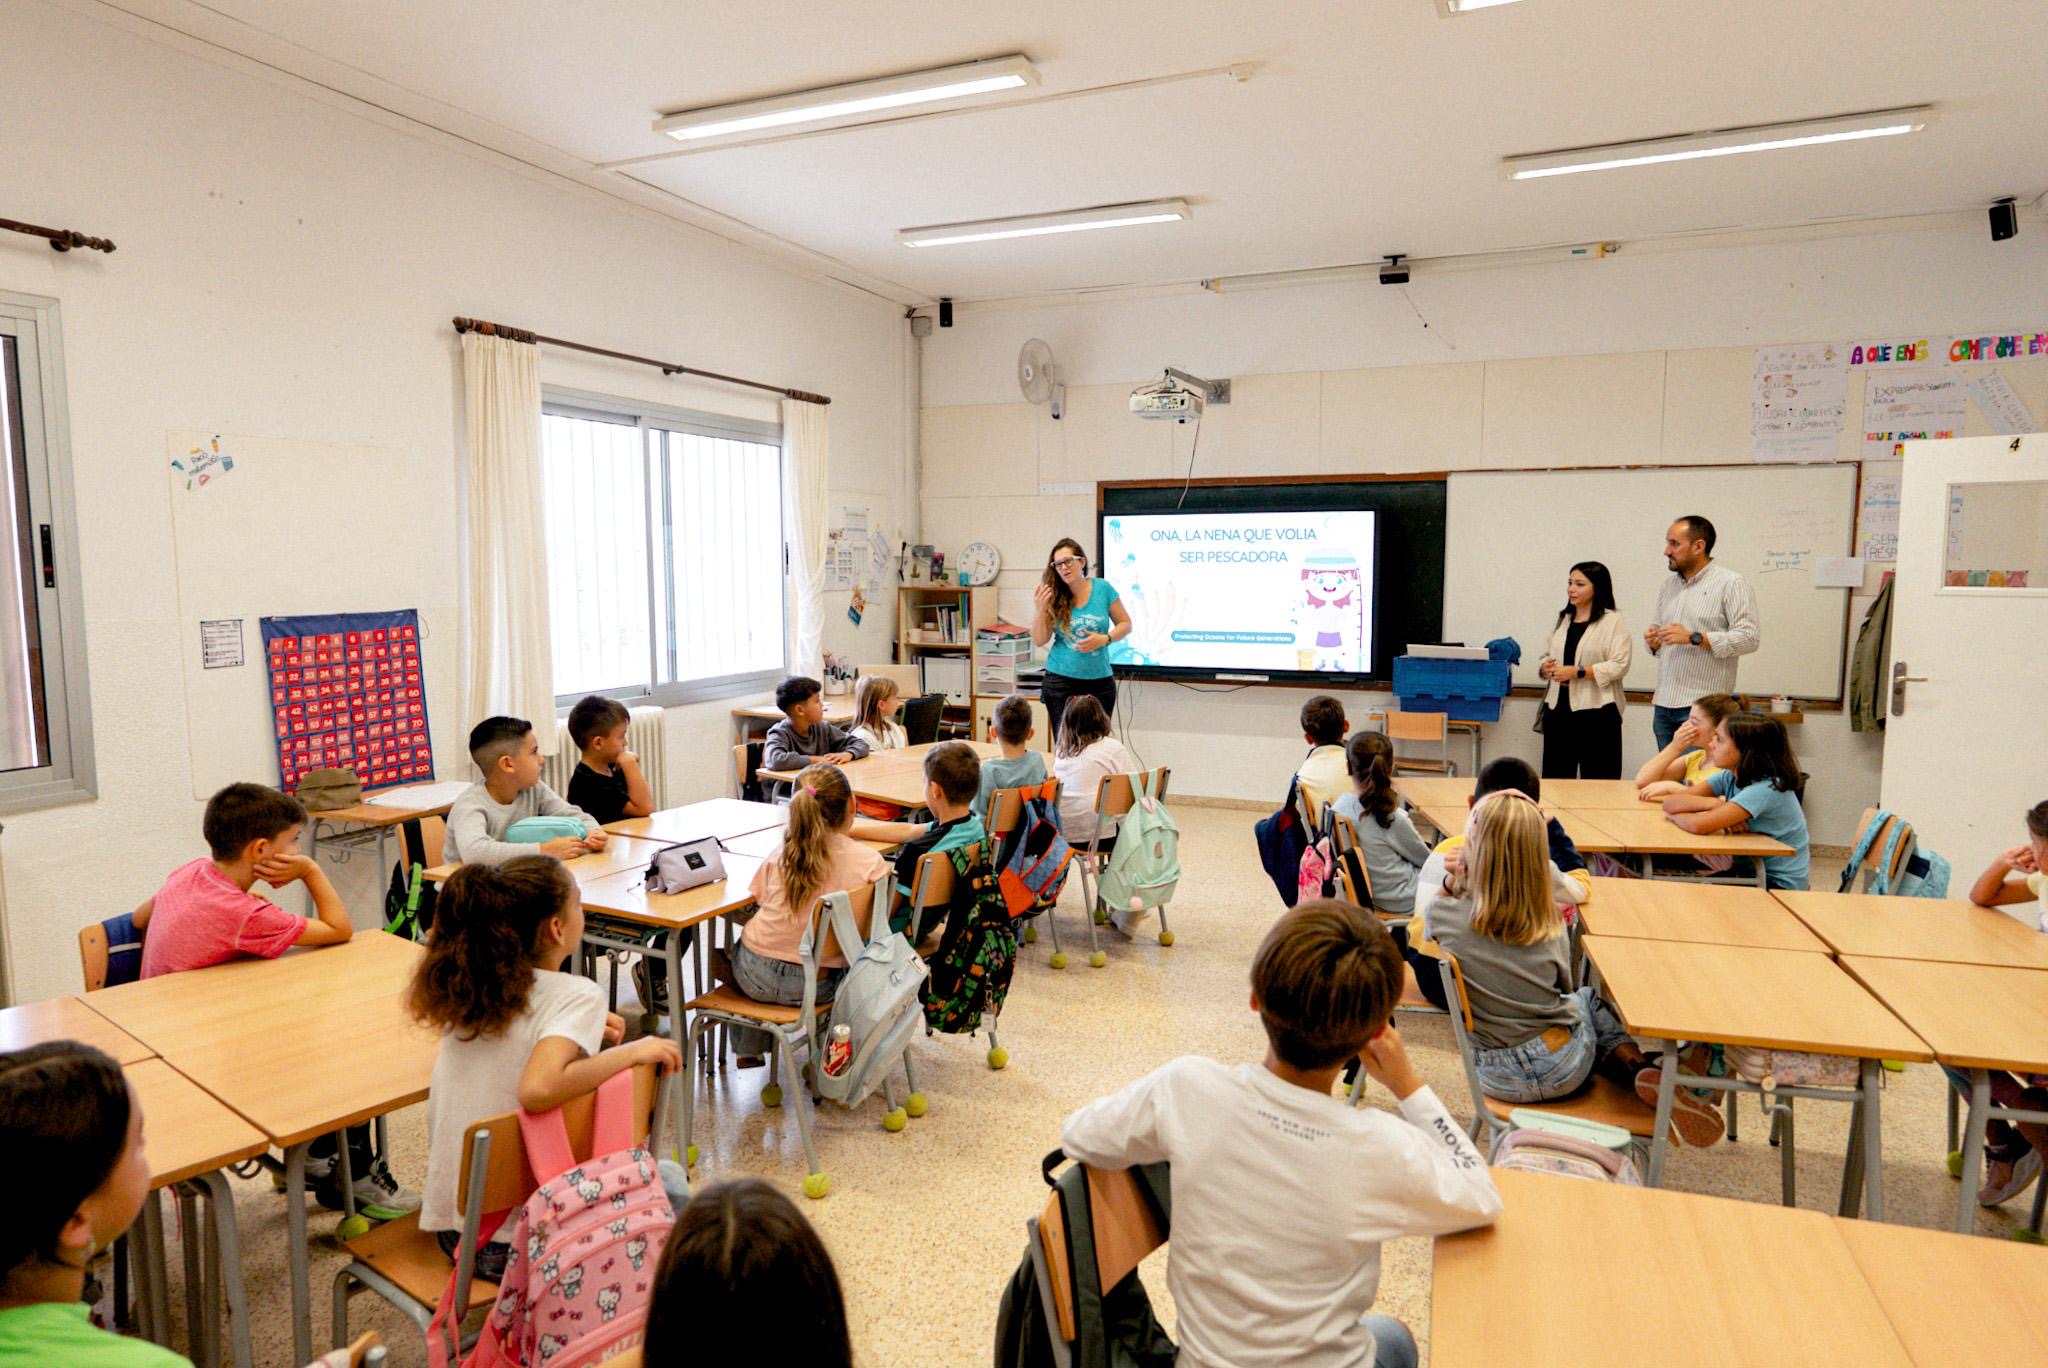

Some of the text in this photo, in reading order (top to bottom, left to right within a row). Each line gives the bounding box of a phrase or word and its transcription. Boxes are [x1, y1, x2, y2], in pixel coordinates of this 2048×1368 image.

[1851, 346, 1863, 364] A
[1895, 339, 1929, 362] ENS
[2010, 438, 2020, 451] 4
[1150, 528, 1317, 543] ONA, LA NENA QUE VOLIA
[1179, 551, 1288, 563] SER PESCADORA
[288, 640, 294, 649] 2
[350, 634, 356, 643] 6
[404, 629, 412, 637] 10
[410, 704, 421, 713] 60
[412, 719, 423, 727] 70
[414, 734, 425, 743] 80
[1271, 1122, 1280, 1130] TO
[1282, 1119, 1299, 1128] NEW
[1303, 1126, 1331, 1138] JERSEY
